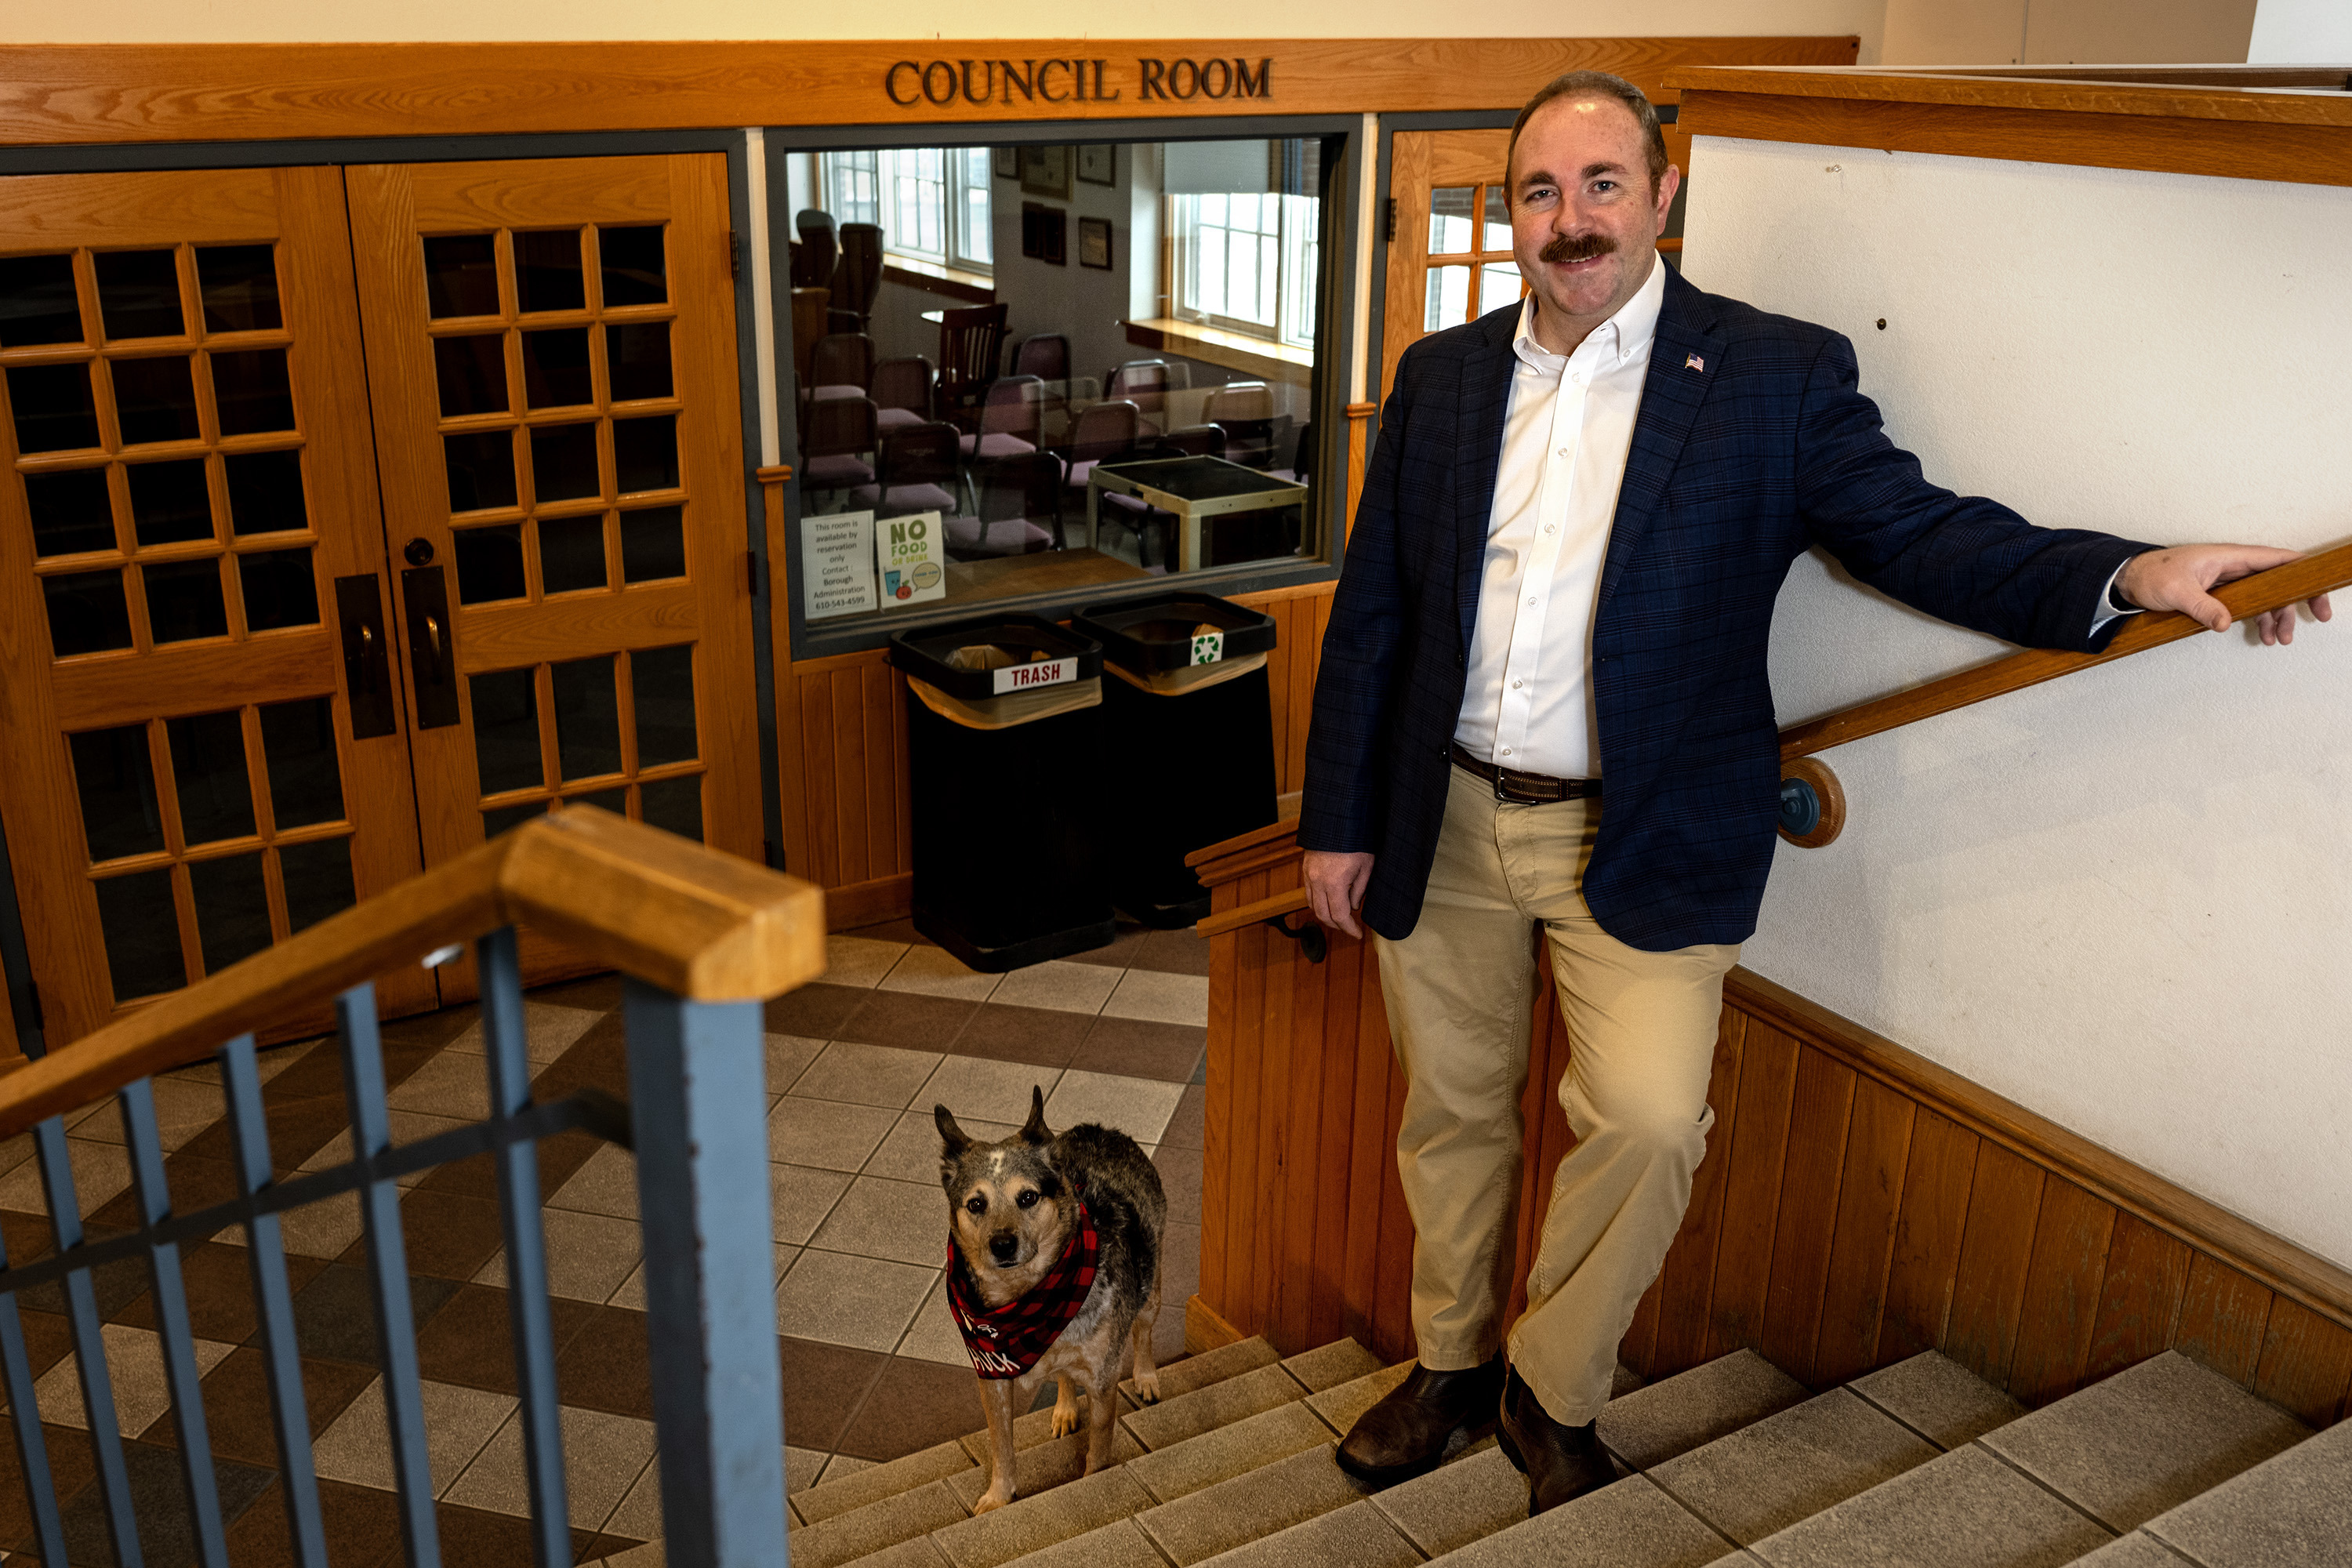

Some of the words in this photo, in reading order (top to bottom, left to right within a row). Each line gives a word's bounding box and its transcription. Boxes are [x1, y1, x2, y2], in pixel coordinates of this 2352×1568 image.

[885, 59, 1120, 105] COUNCIL
[1138, 57, 1273, 100] ROOM
[816, 533, 847, 543] available
[849, 531, 858, 539] by
[891, 519, 927, 545] NO
[817, 543, 857, 554] reservation
[891, 541, 927, 557] FOOD
[829, 554, 845, 563] only
[823, 575, 853, 586] Borough
[814, 586, 866, 599] Administration
[815, 596, 866, 609] 610-543-4599
[1011, 663, 1060, 686] TRASH
